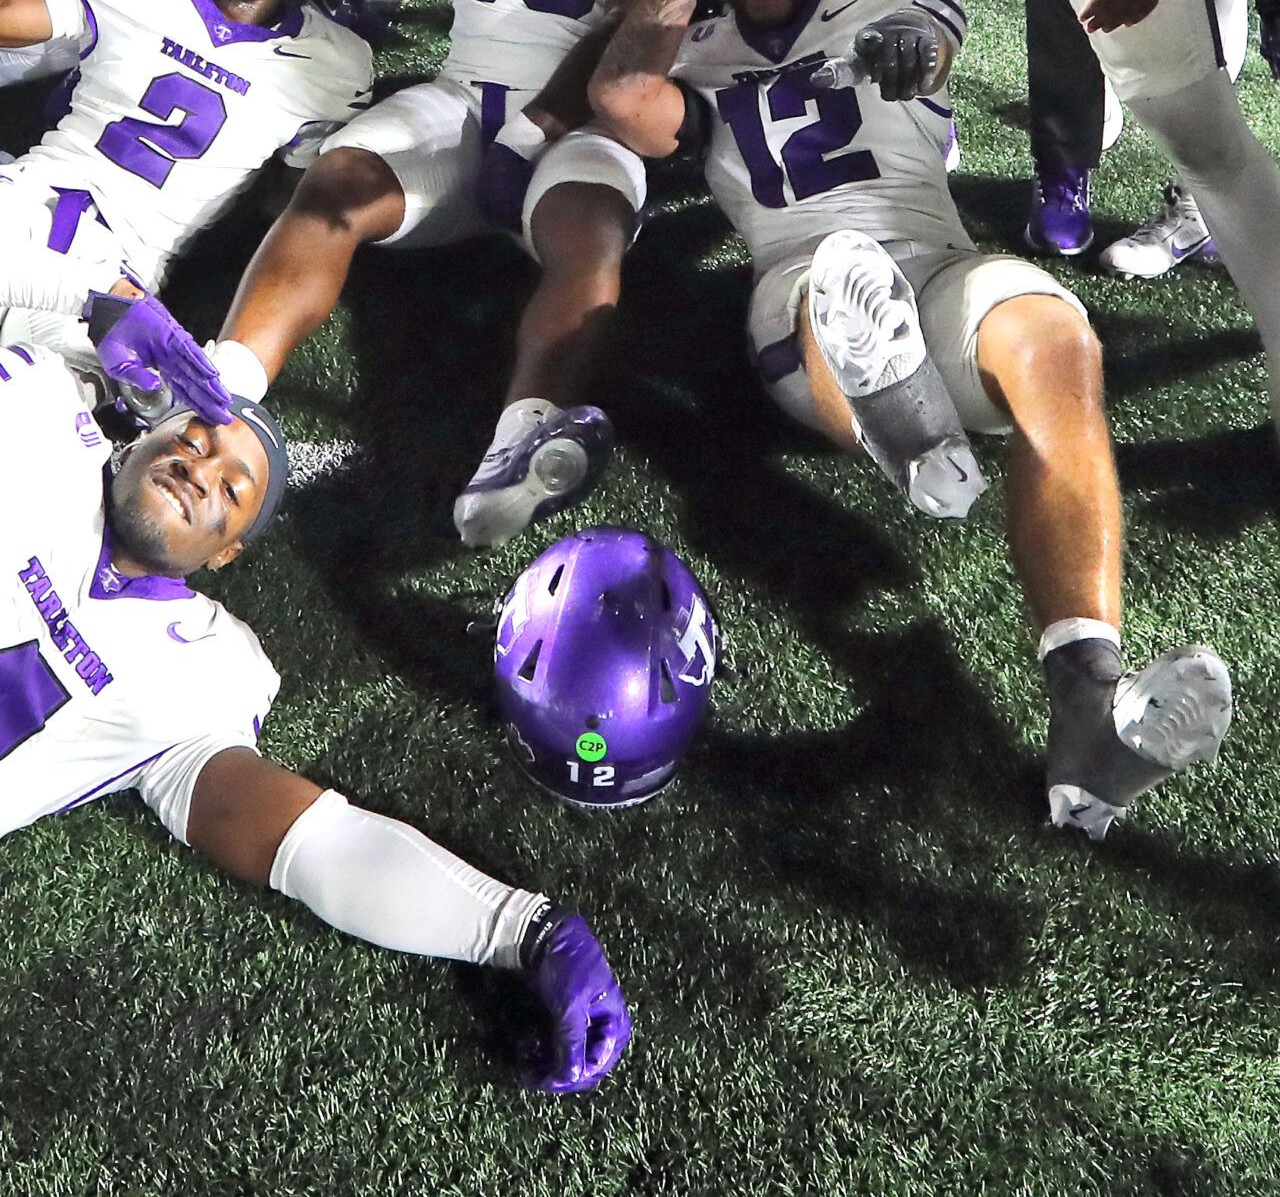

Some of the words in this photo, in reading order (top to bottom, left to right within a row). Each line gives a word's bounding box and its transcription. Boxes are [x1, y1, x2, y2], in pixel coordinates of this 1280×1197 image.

[160, 36, 252, 97] TARLETON
[94, 71, 228, 190] 2
[715, 63, 882, 209] 12
[18, 555, 114, 697] TARLETON
[565, 760, 616, 788] 12
[578, 739, 604, 753] C2P
